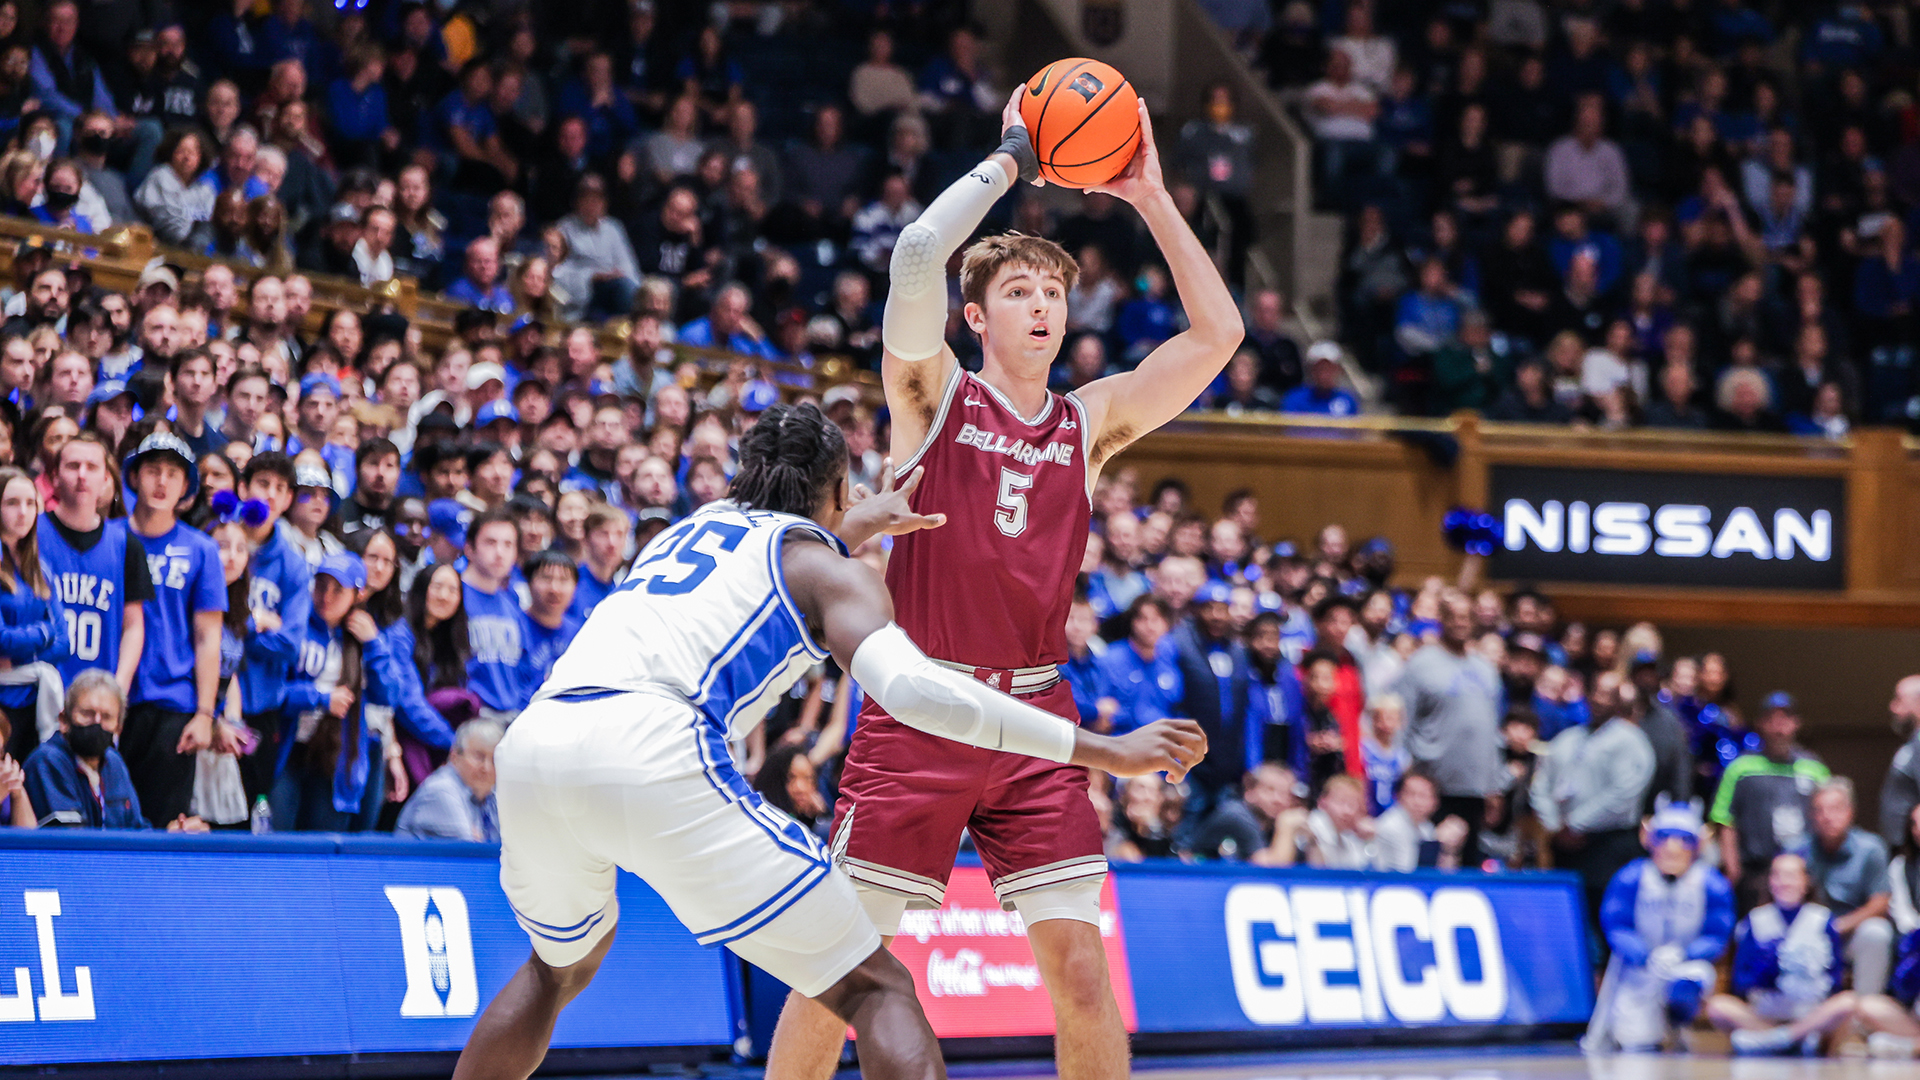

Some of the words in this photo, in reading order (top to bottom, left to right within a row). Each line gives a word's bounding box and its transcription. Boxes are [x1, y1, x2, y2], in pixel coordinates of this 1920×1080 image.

[955, 422, 1075, 466] BELLARMINE
[993, 466, 1033, 538] 5
[1503, 498, 1833, 562] NISSAN
[146, 553, 191, 590] KE
[612, 520, 750, 596] 25
[0, 888, 96, 1021] L
[1224, 883, 1509, 1026] GEICO
